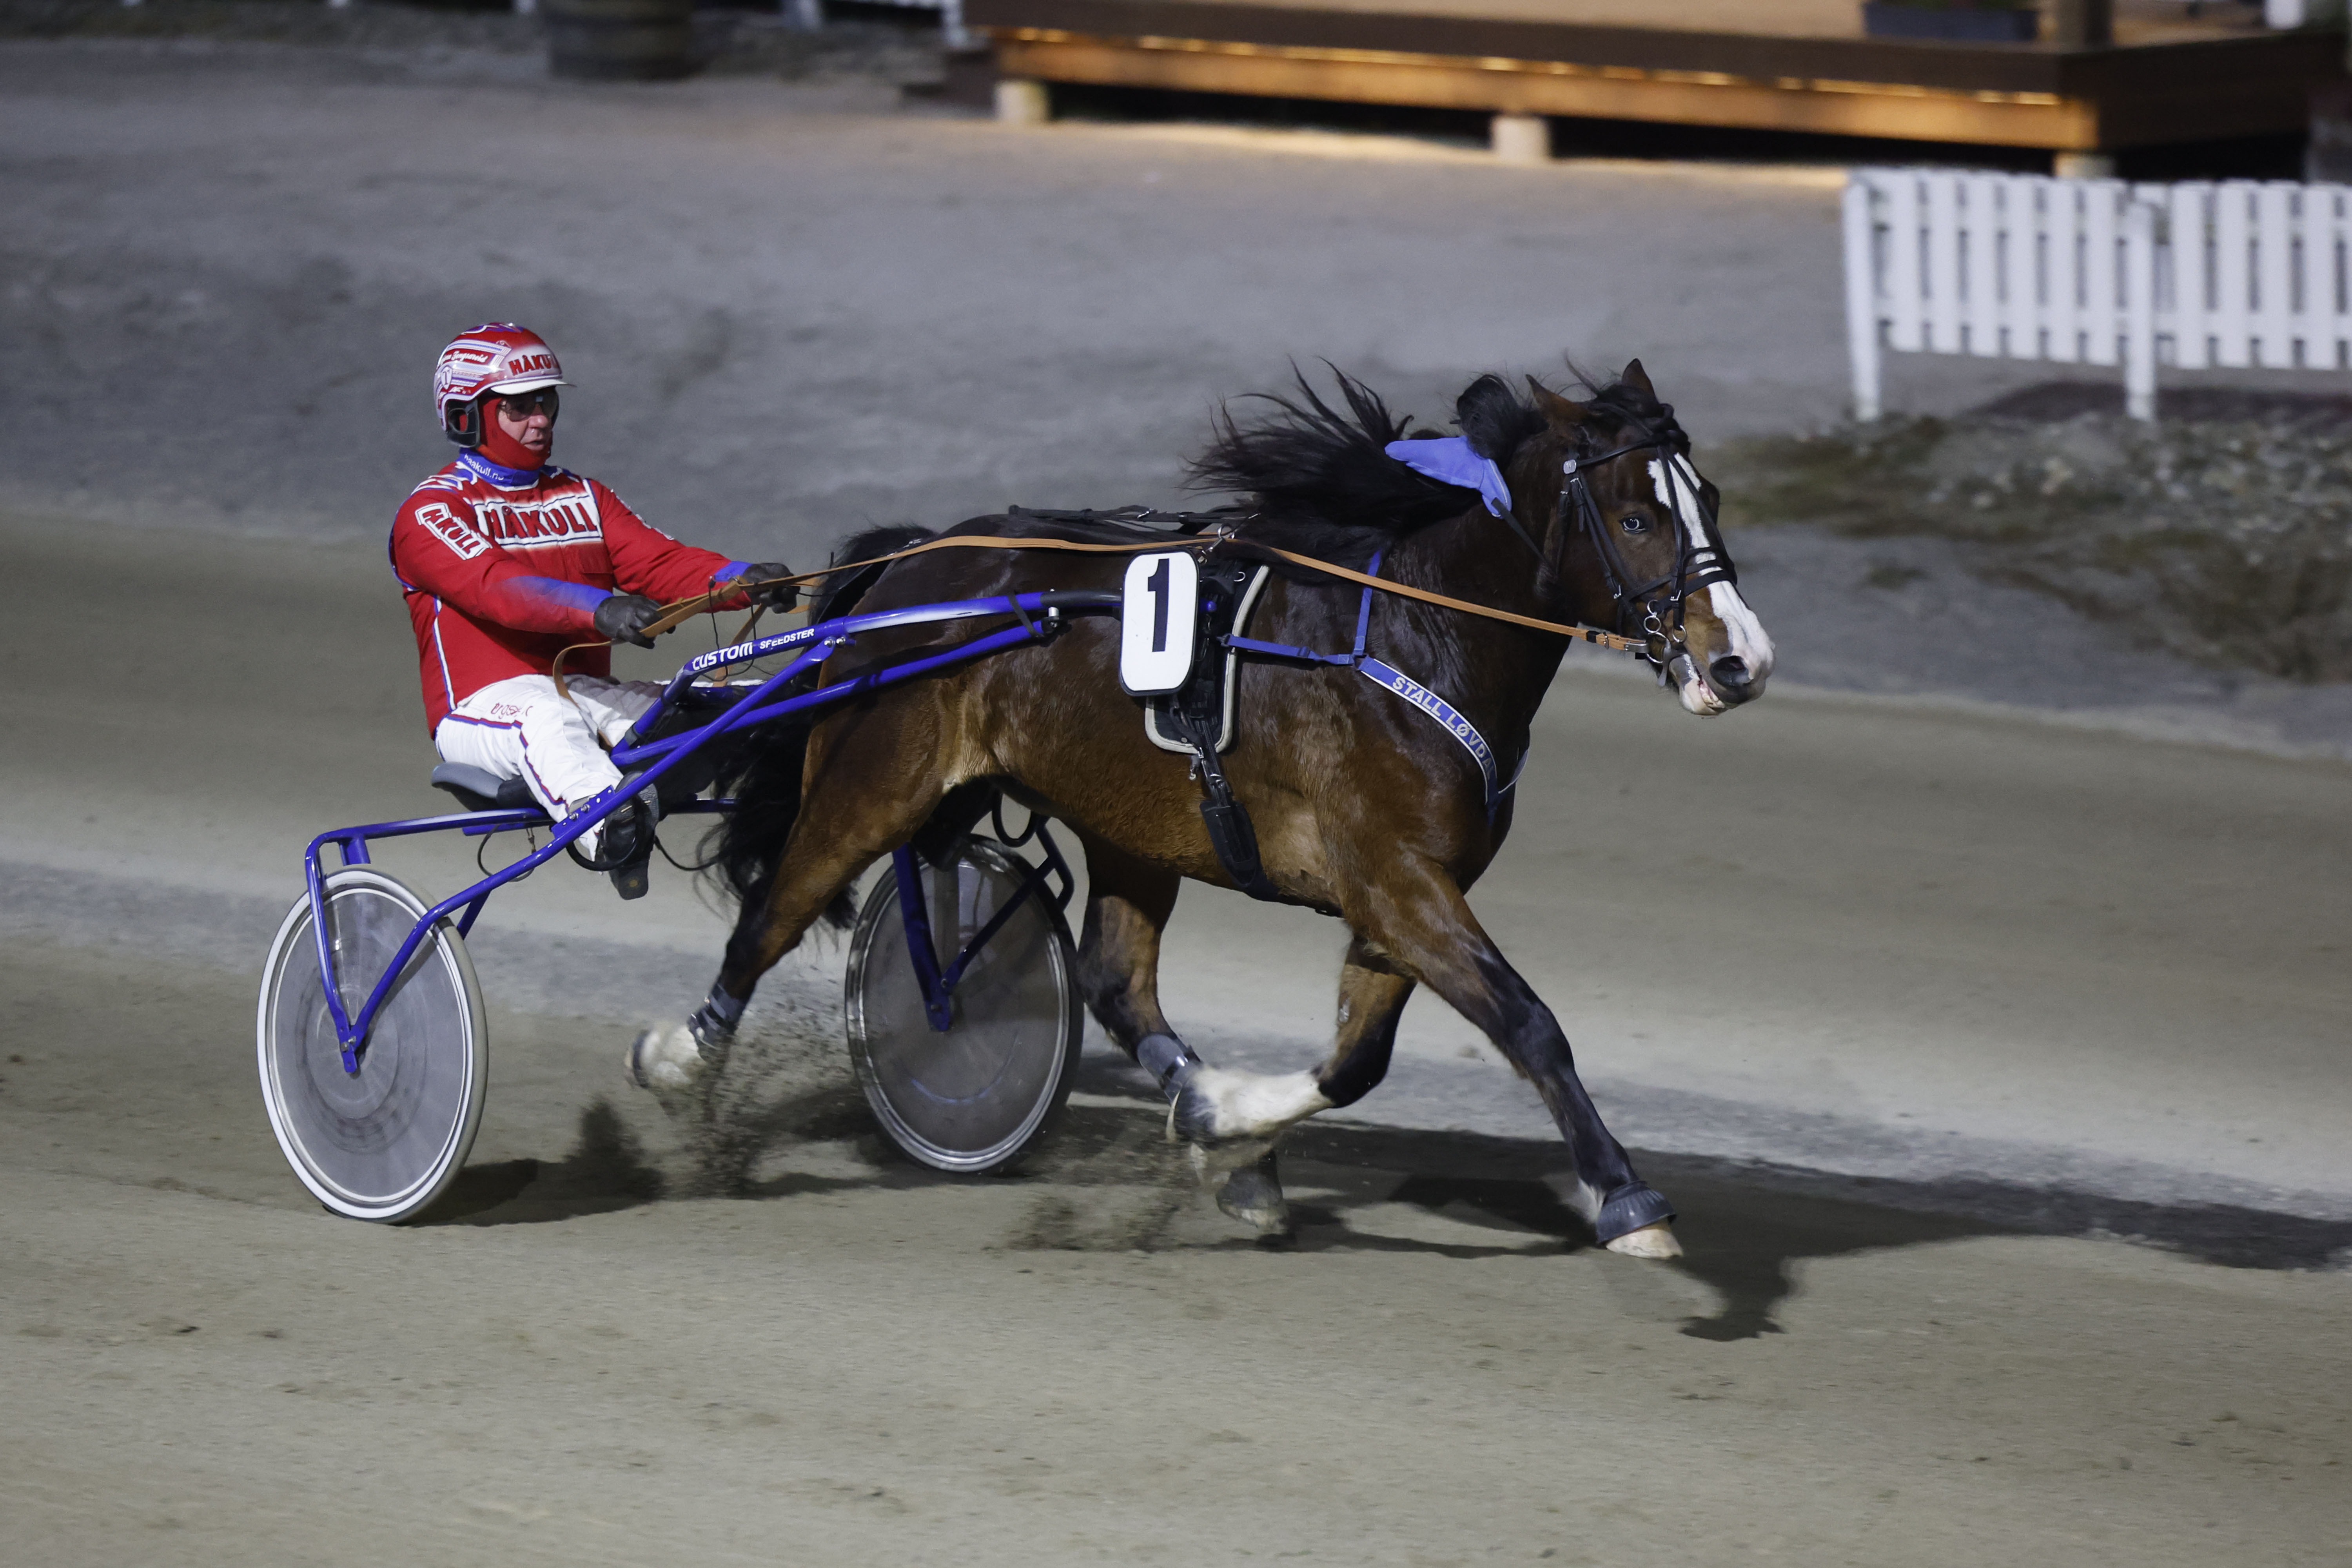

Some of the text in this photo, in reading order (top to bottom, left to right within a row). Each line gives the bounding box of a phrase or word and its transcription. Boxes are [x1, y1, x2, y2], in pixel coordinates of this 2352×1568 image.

[483, 502, 598, 539] HÅKULL
[1147, 558, 1170, 652] 1
[691, 628, 815, 671] CUSTOM SPEEDSTER
[1392, 677, 1441, 717] STALL
